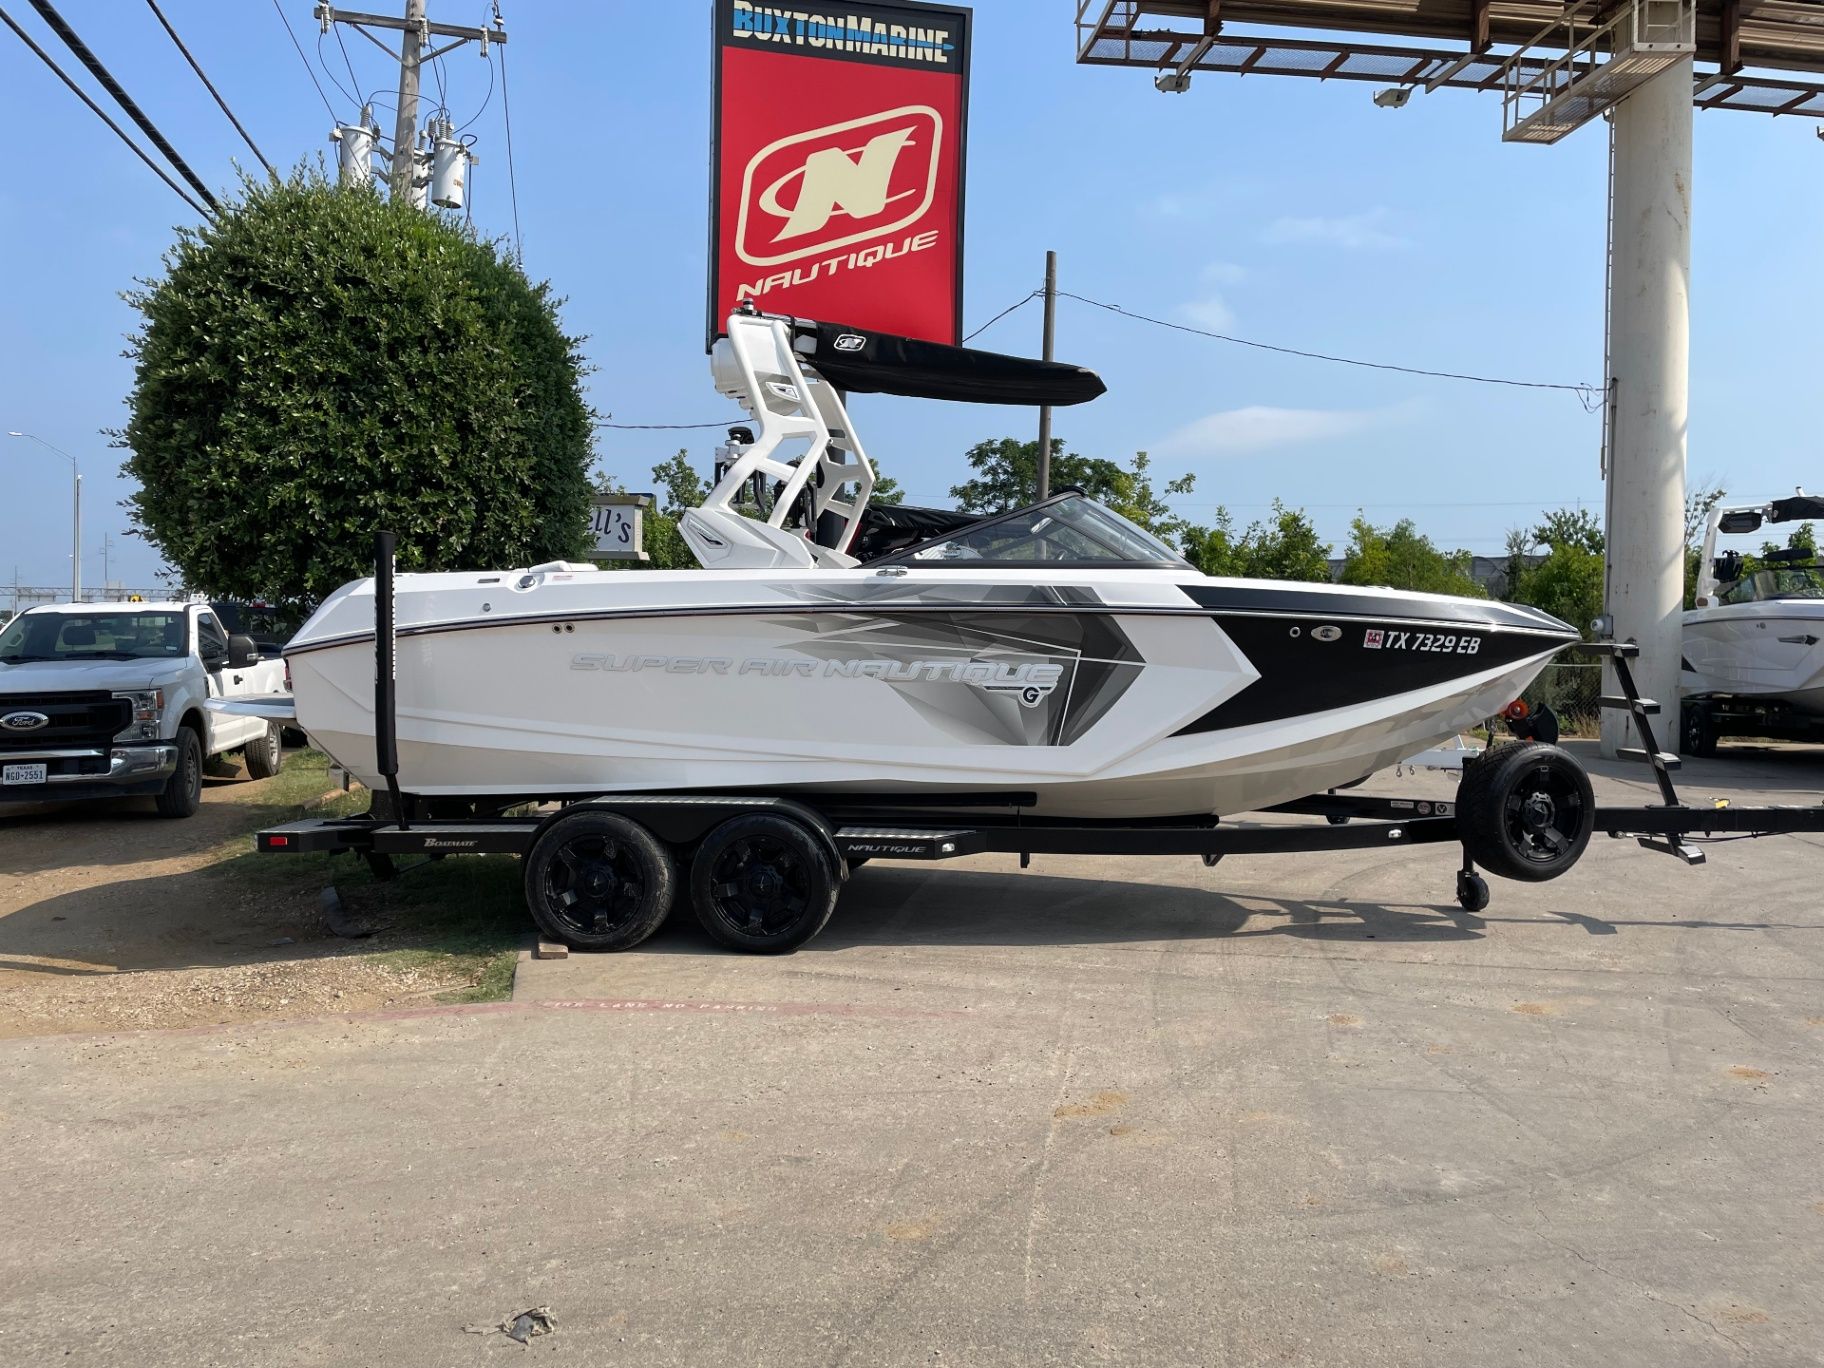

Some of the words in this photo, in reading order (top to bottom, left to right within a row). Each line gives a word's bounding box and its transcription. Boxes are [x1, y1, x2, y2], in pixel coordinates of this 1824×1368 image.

[736, 230, 939, 302] NAUTIQUE
[1386, 631, 1410, 650] TX
[1411, 633, 1457, 653] 7329
[1456, 636, 1481, 655] EB
[570, 652, 733, 676] SUPER
[738, 656, 819, 678] AIR
[823, 659, 1064, 685] NAUTIQUE
[12, 716, 36, 726] Ford
[847, 844, 927, 853] NAUTIQUE
